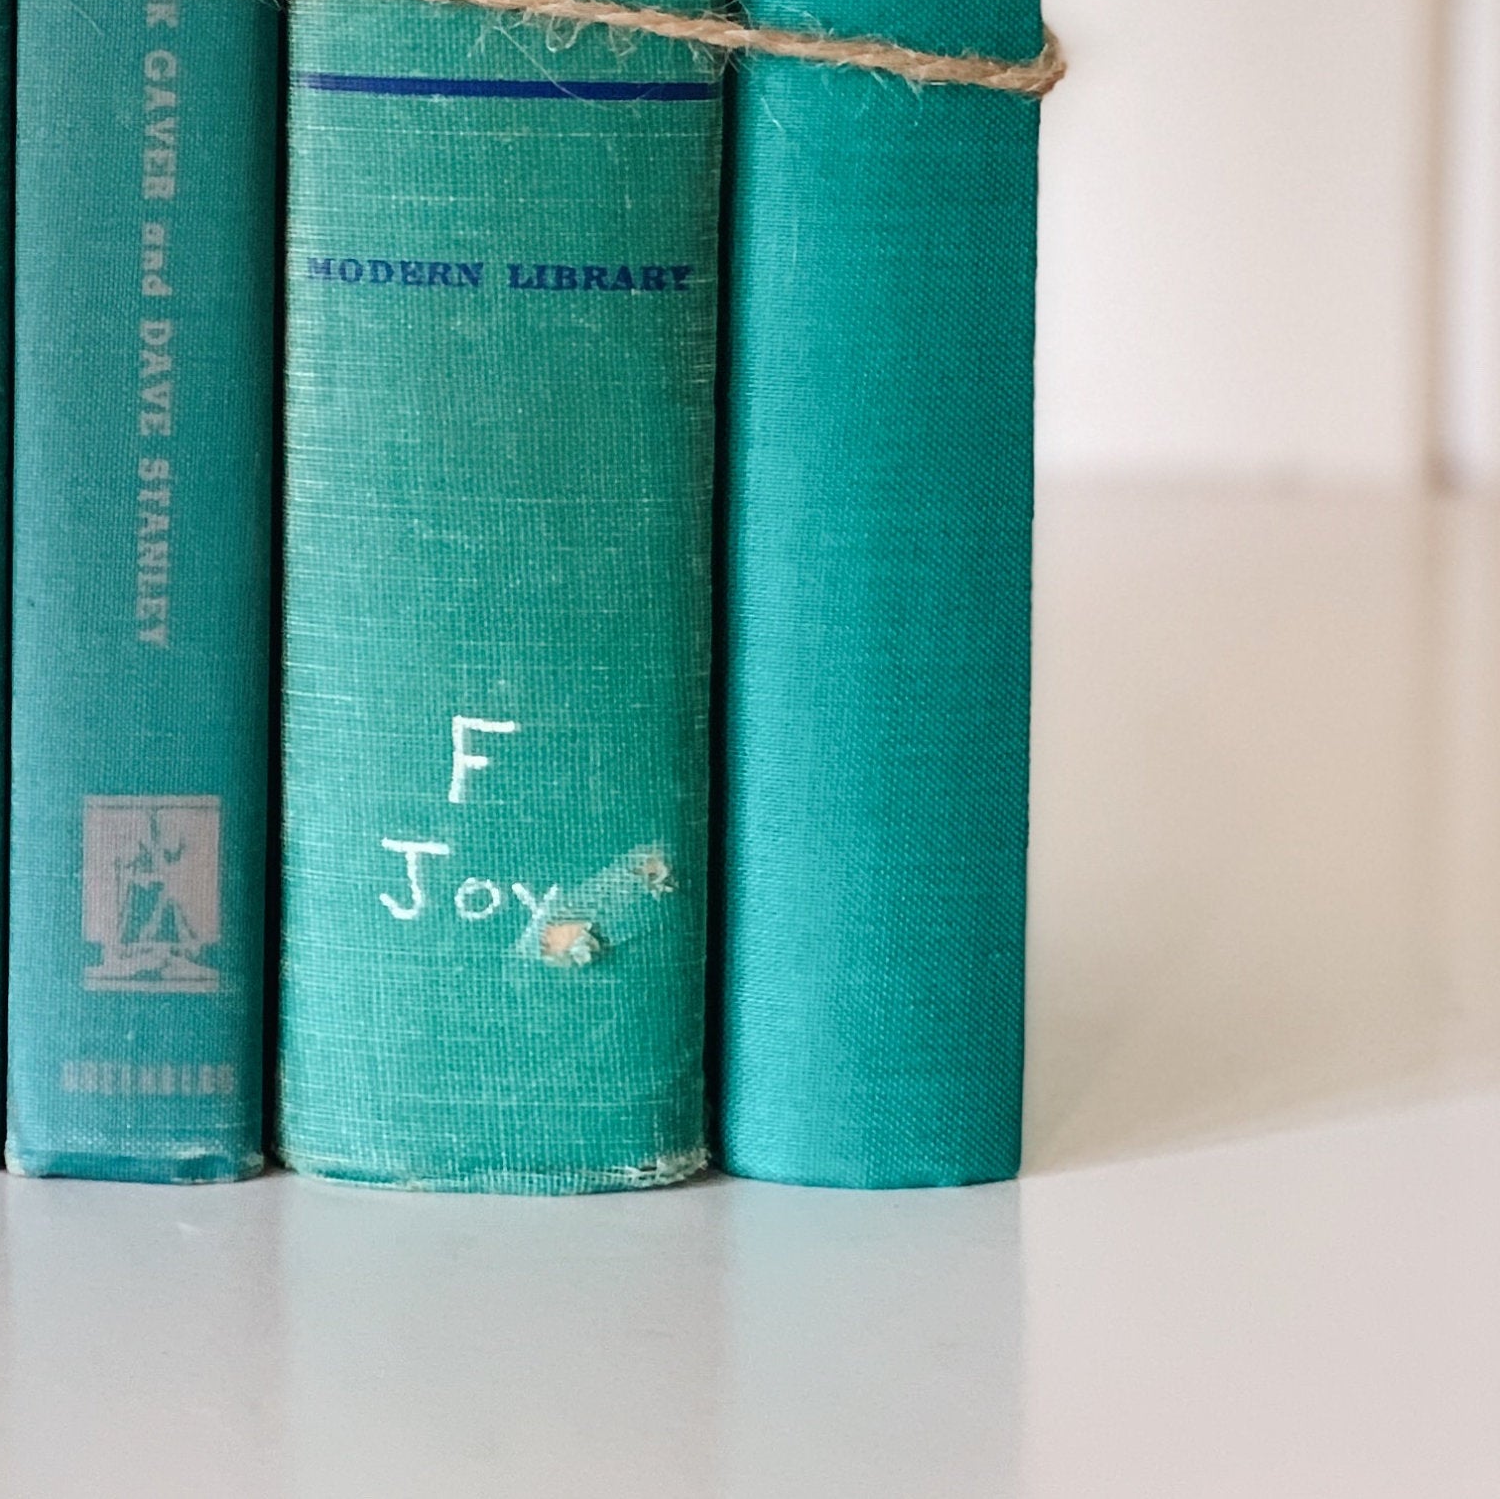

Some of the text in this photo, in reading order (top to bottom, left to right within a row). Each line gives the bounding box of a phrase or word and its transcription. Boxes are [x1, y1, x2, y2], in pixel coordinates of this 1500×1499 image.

[140, 221, 174, 299] and
[306, 256, 694, 292] MODERN LIBRARY
[138, 318, 174, 438] DAVE
[135, 456, 172, 651] STANLEY
[447, 713, 520, 804] F
